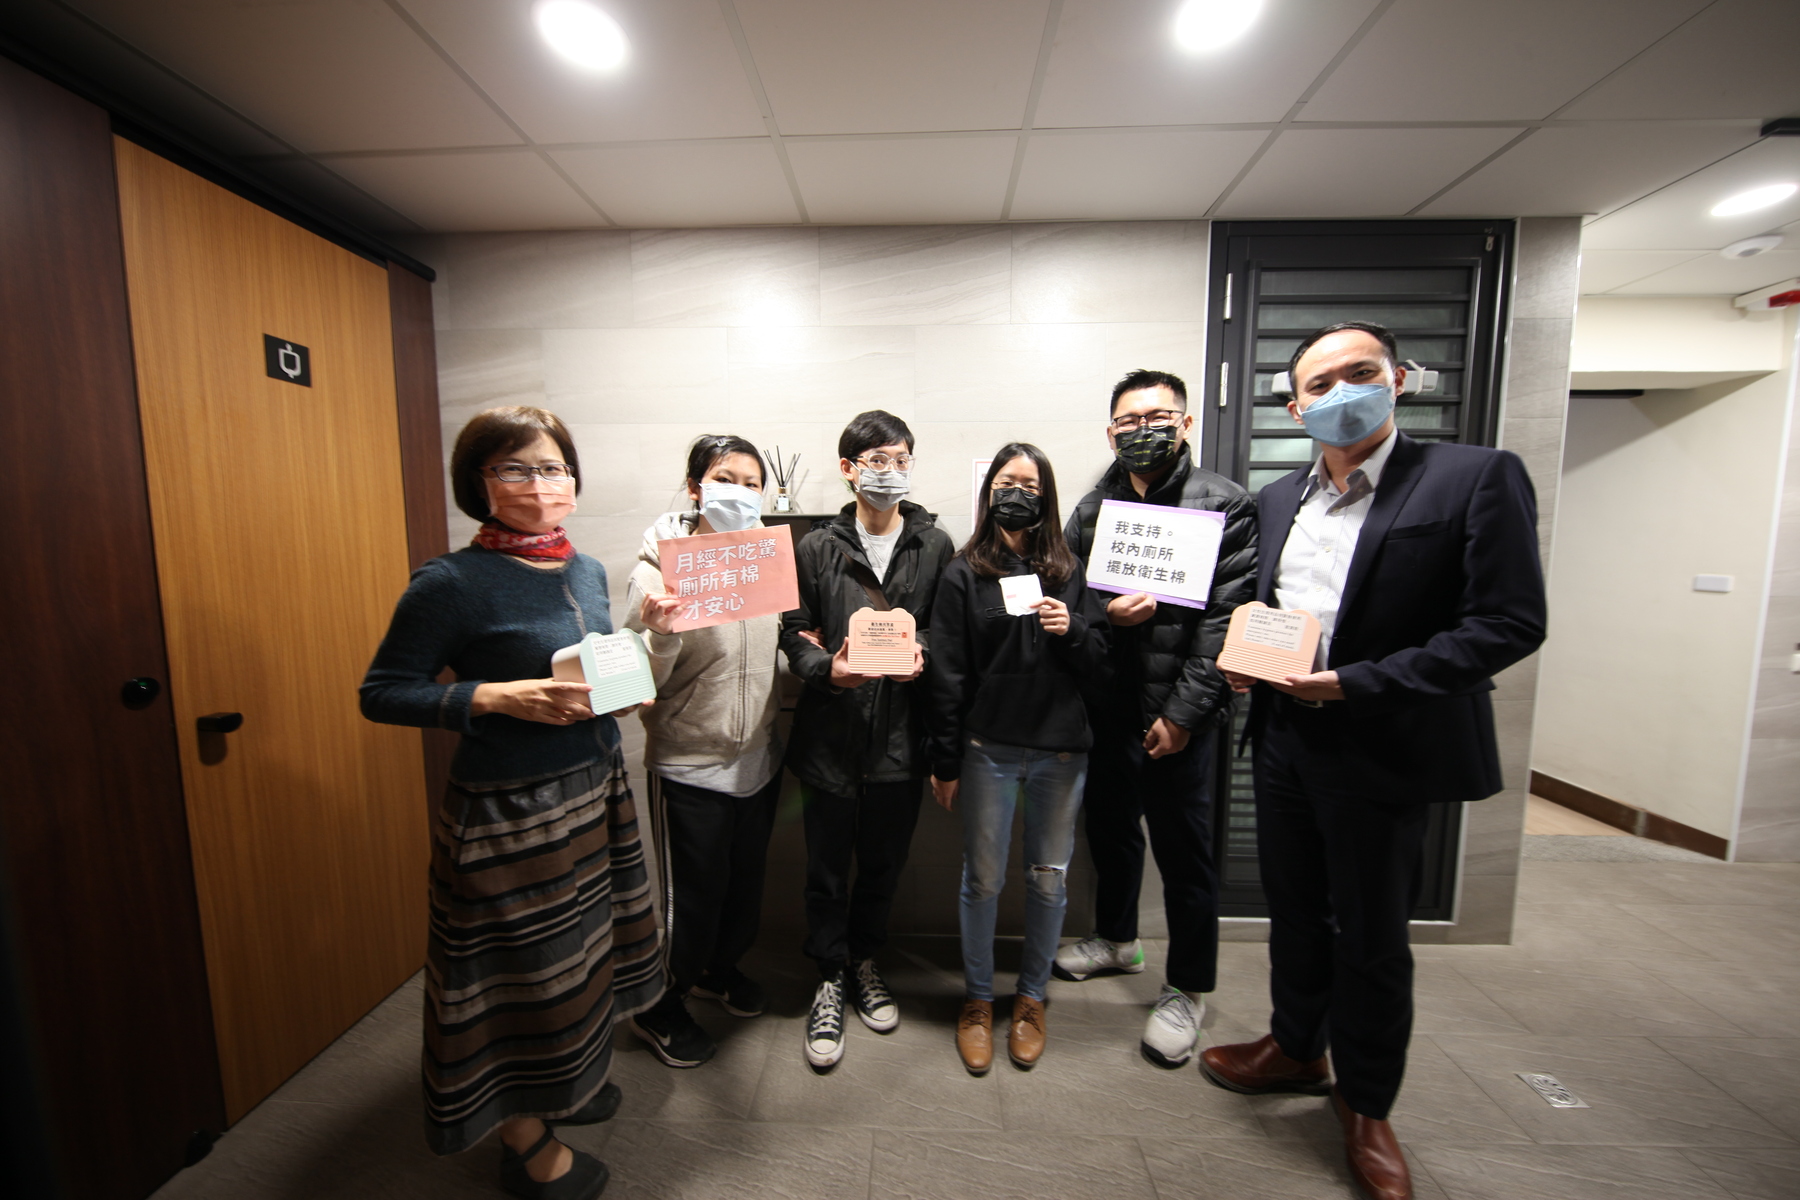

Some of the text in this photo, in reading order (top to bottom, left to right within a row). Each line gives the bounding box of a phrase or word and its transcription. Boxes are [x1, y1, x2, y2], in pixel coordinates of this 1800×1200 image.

[1115, 520, 1174, 539] 我支持。
[675, 538, 777, 574] 月經不吃驚
[1110, 540, 1174, 562] 校內廁所
[678, 564, 760, 598] 廁所有棉
[1106, 559, 1186, 585] 擺放衛生棉
[684, 592, 745, 621] 才安心
